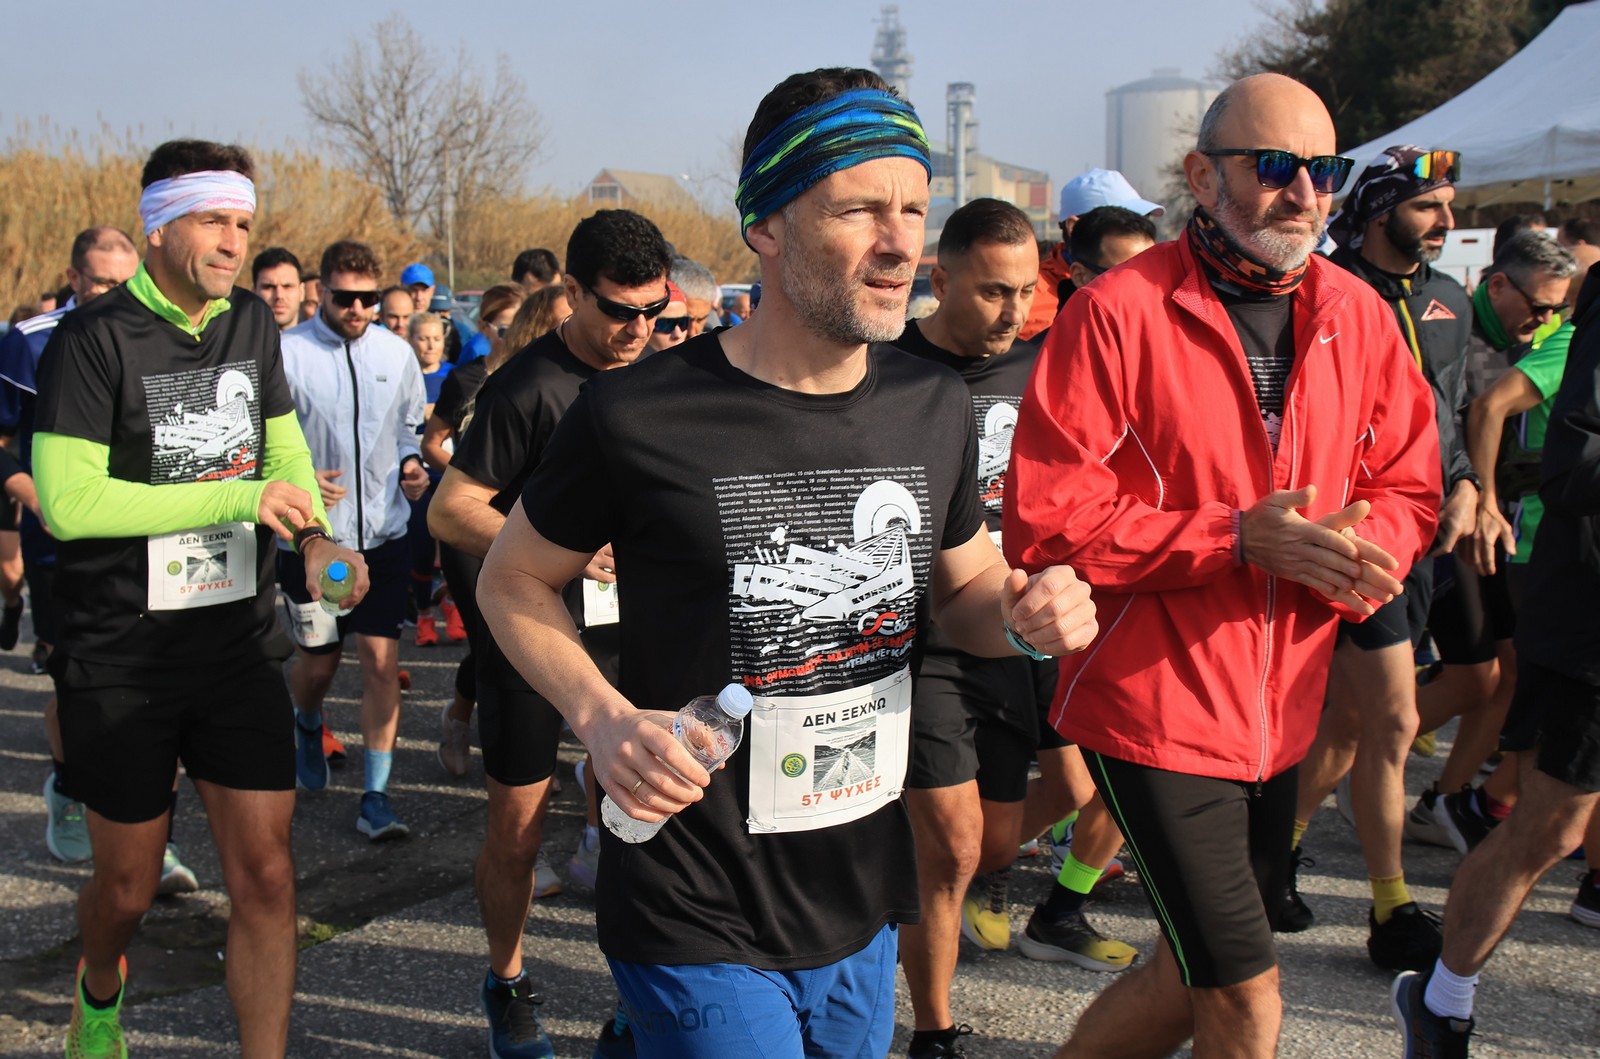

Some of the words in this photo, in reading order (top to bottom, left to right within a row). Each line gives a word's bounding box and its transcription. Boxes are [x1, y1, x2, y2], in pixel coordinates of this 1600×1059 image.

[179, 536, 200, 545] ΔΕΝ
[203, 530, 233, 543] ΞΕΧΝΩ
[180, 585, 193, 594] 57
[198, 579, 234, 592] ΨΥΧΕΣ
[802, 711, 836, 728] ΔΕΝ
[841, 697, 886, 721] ΞΕΧΝΩ
[801, 793, 823, 806] 57
[830, 776, 881, 801] ΨΥΧΕΣ
